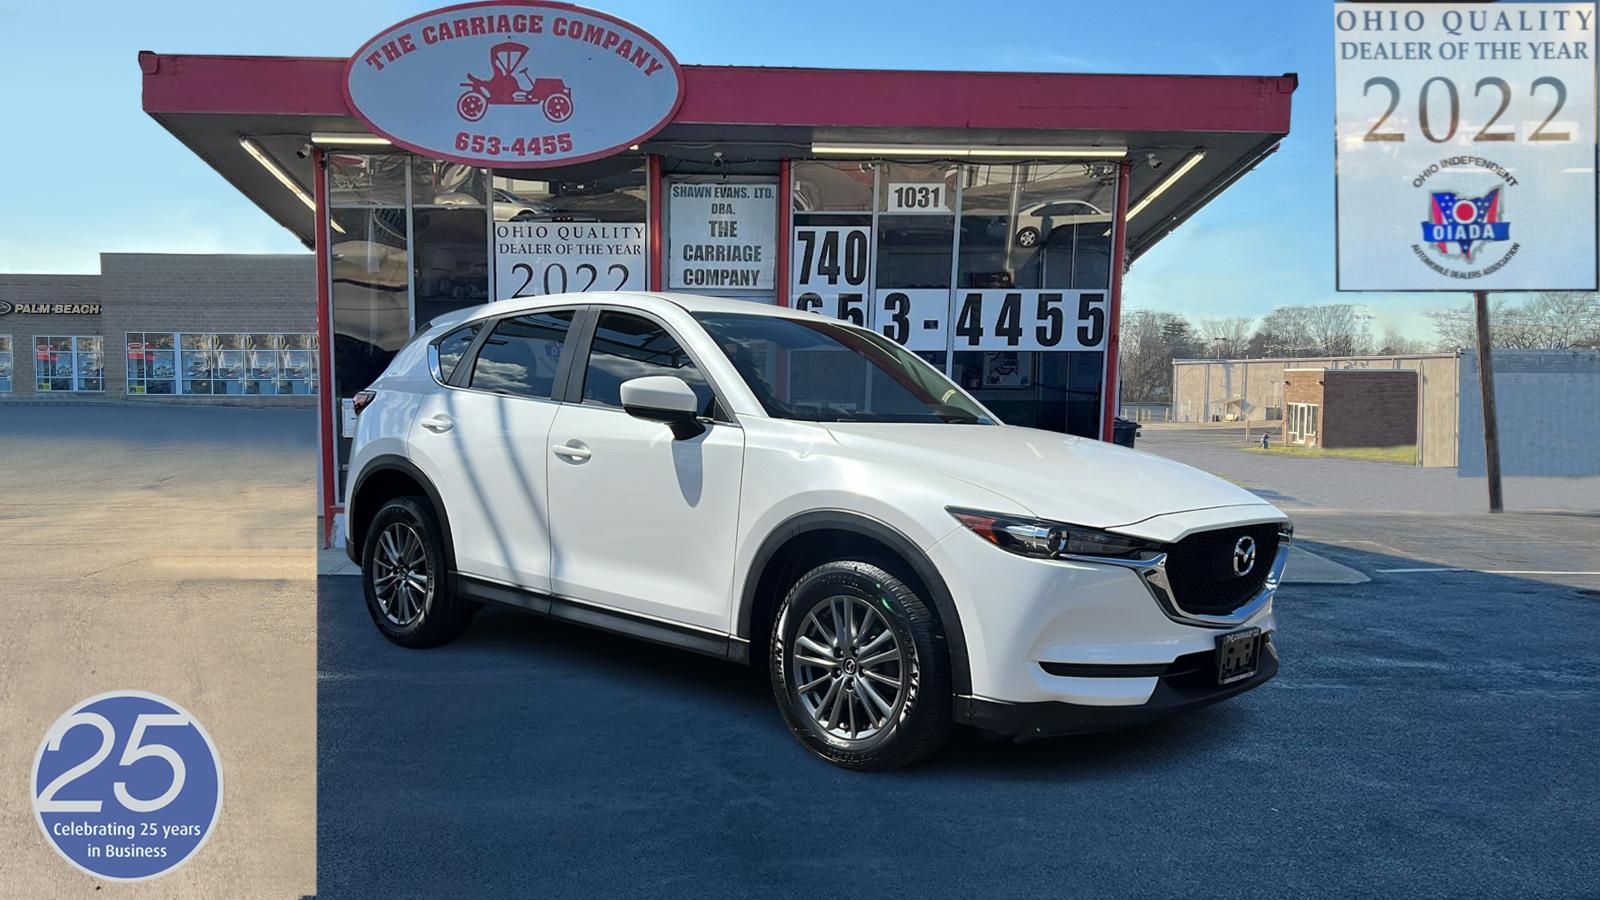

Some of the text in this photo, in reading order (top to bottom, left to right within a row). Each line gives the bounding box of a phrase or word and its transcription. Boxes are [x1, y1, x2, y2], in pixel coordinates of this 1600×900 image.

[1337, 10, 1592, 35] OHIO QUALITY
[366, 14, 664, 77] THE CARRIAGE COMPANY
[1340, 42, 1589, 60] DEALER OF THE YEAR
[1363, 76, 1570, 143] 2022
[455, 132, 572, 156] 653-4455
[1413, 156, 1519, 188] OHIO INDEPENDENT
[672, 186, 712, 198] SHAWN
[754, 187, 774, 199] LTD.
[894, 187, 940, 208] 1031
[711, 204, 736, 215] DBA.
[497, 226, 644, 241] OHIO QUALITY
[708, 220, 738, 238] THE
[1433, 224, 1495, 241] OIADA
[500, 244, 641, 255] DEALER OF THE YEAR
[683, 245, 762, 262] CARRIAGE
[797, 230, 868, 286] 740
[1411, 243, 1520, 279] AUTOMOBILE DEALERS ASSOCIATION
[511, 262, 630, 299] 2022
[683, 268, 760, 286] COMPANY
[15, 304, 100, 314] PALM BEACH
